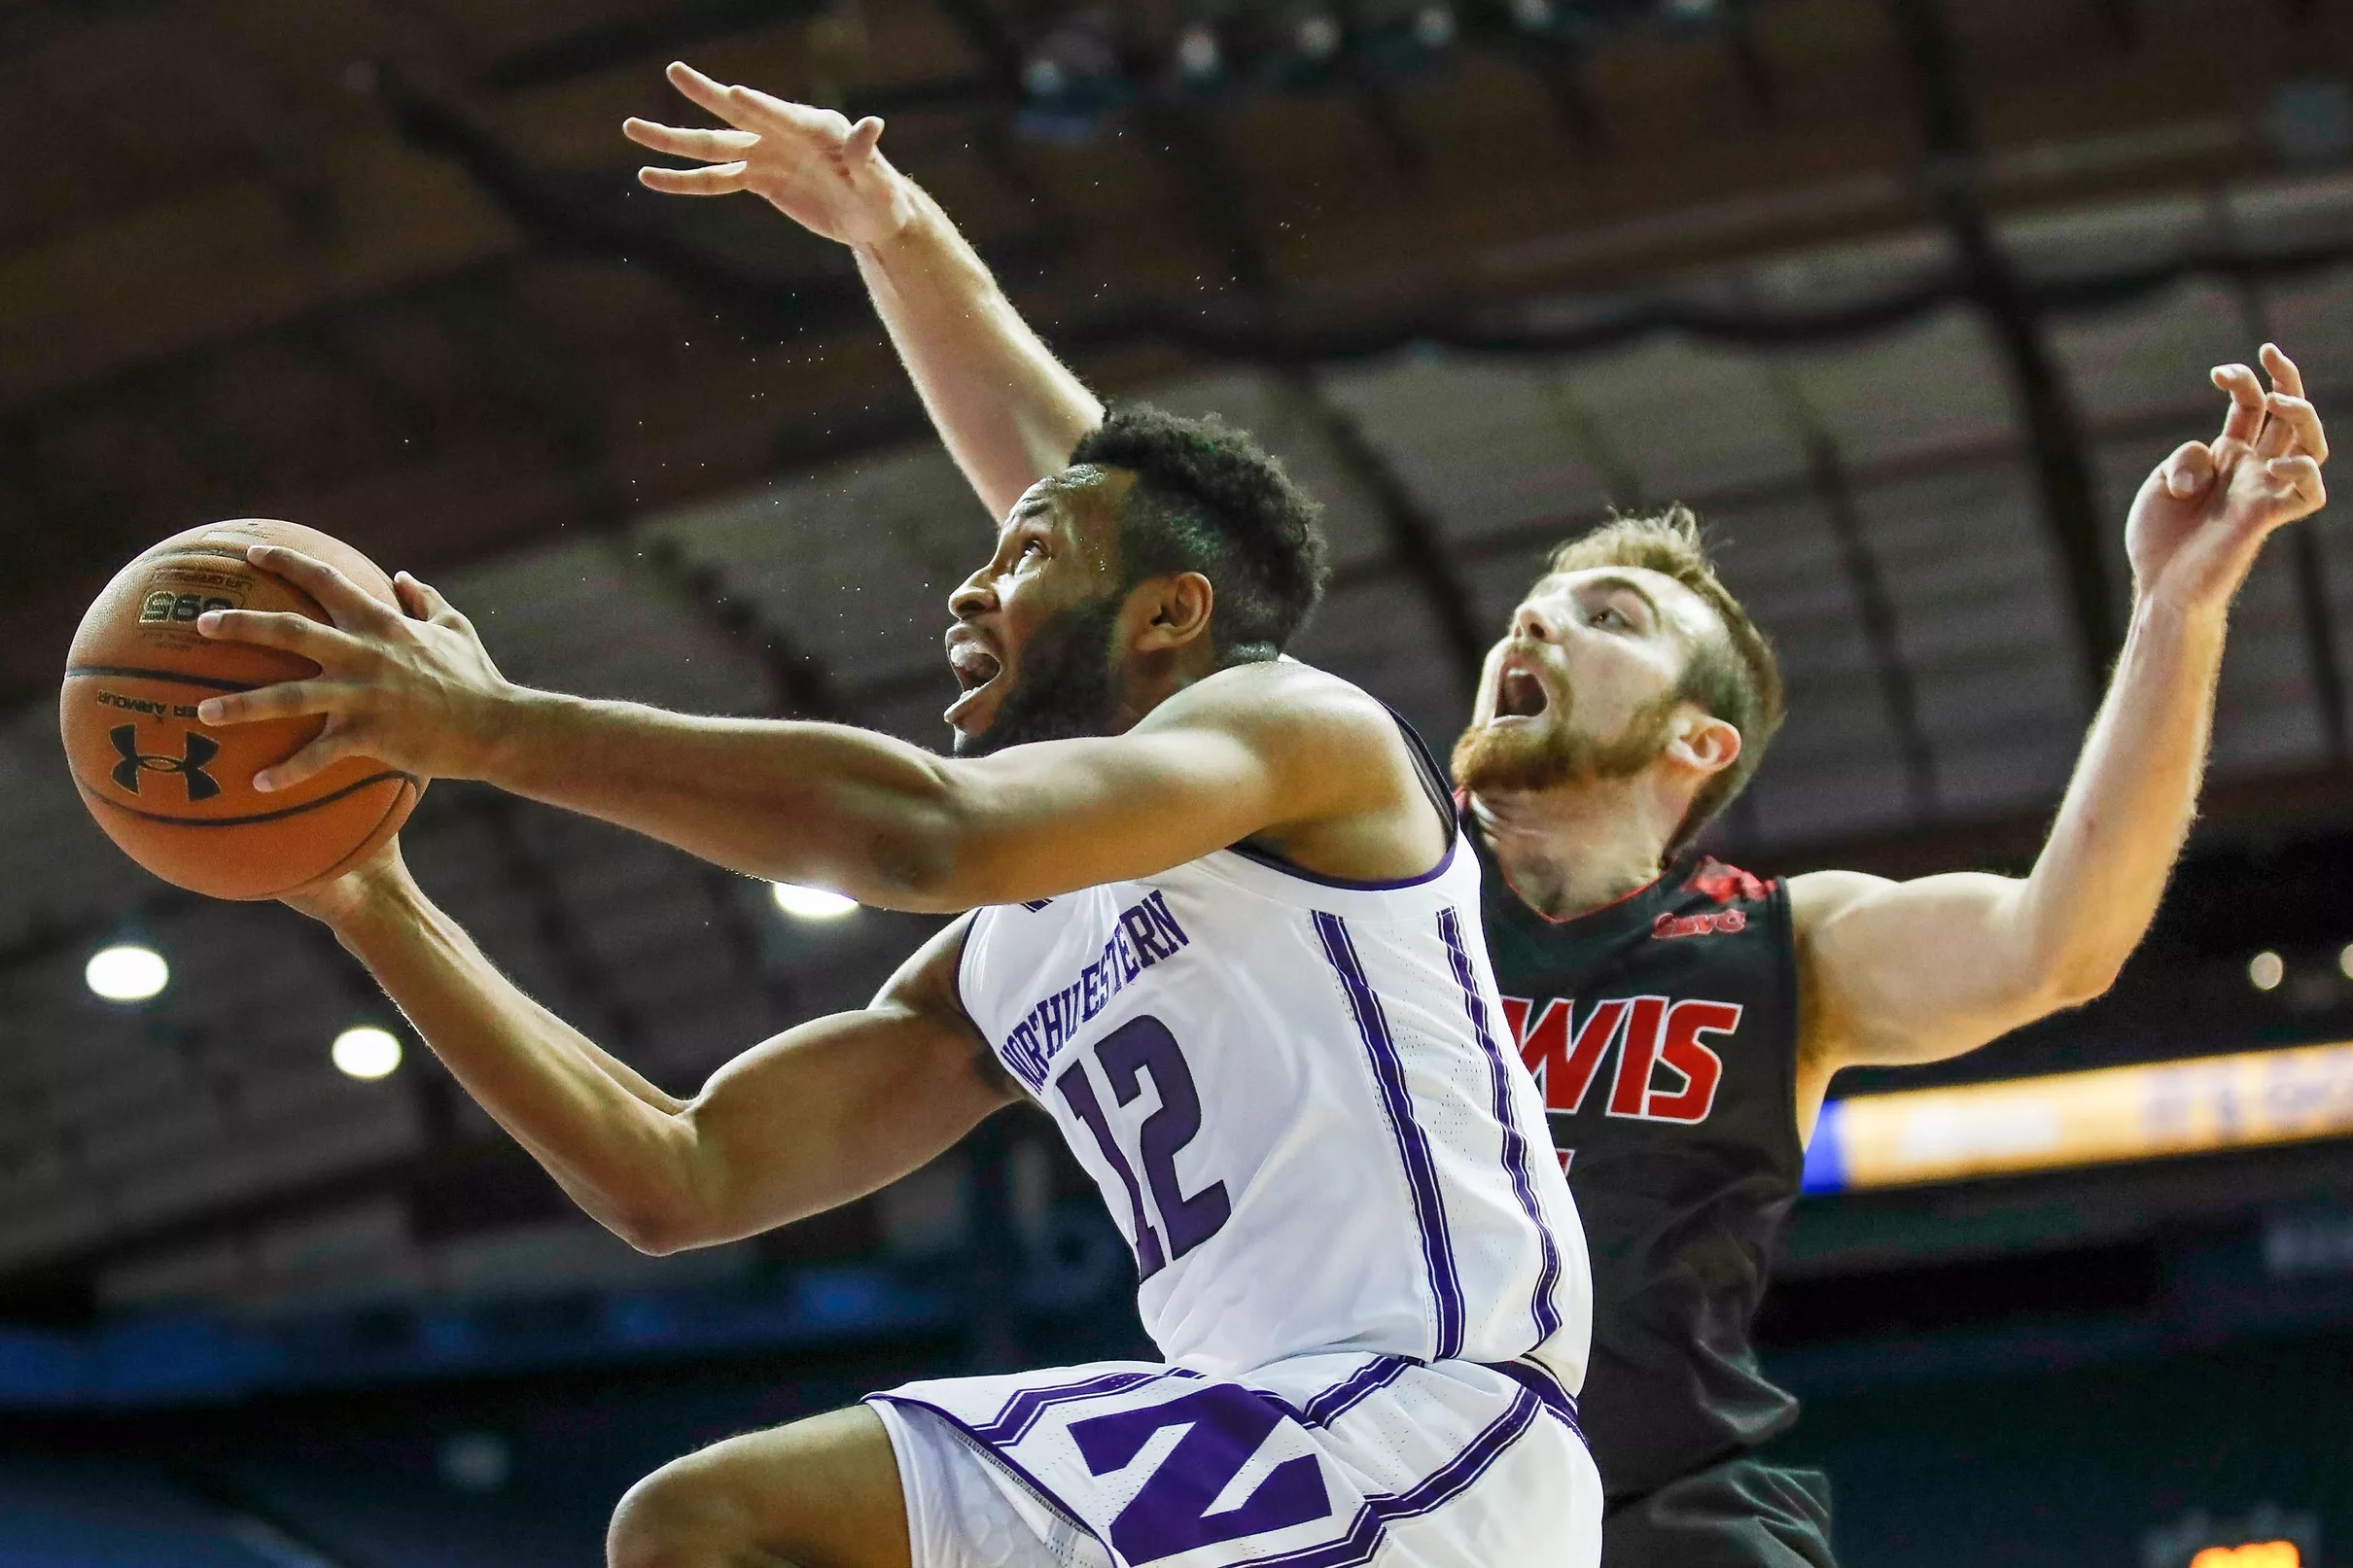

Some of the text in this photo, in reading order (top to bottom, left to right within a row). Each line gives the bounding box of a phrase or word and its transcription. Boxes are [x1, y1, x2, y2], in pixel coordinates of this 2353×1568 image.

[1000, 889, 1190, 1096] NORHWESTERN
[1501, 994, 1744, 1126] WIS
[1056, 1014, 1232, 1285] 12
[1067, 1382, 1334, 1568] N
